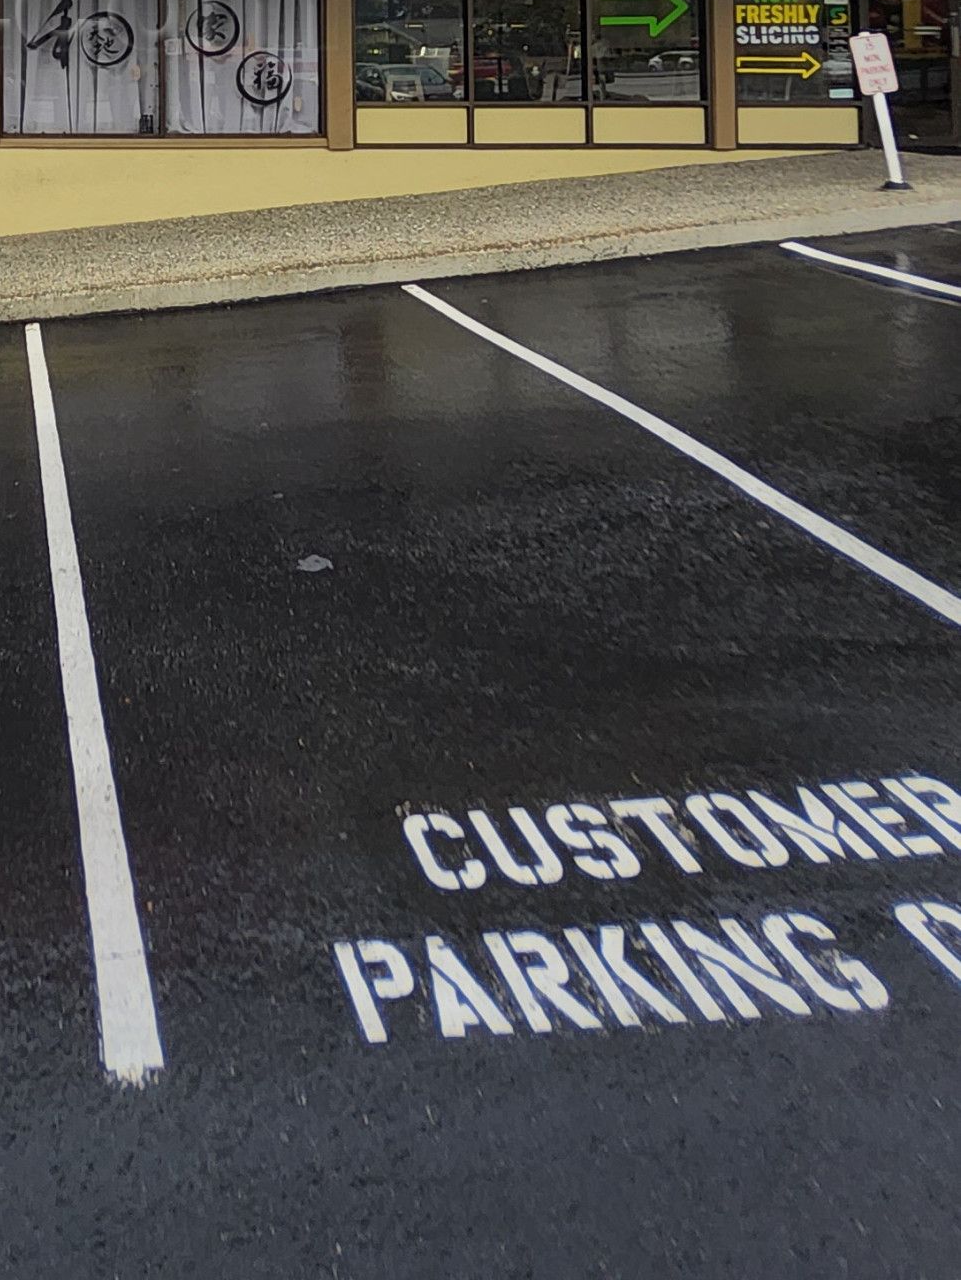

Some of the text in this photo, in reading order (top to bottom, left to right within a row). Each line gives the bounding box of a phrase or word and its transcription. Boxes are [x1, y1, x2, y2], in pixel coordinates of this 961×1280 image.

[735, 4, 820, 23] FRESHLY
[736, 25, 820, 45] SLICING
[402, 774, 961, 891] CUSTOMER
[332, 911, 890, 1044] PARKING
